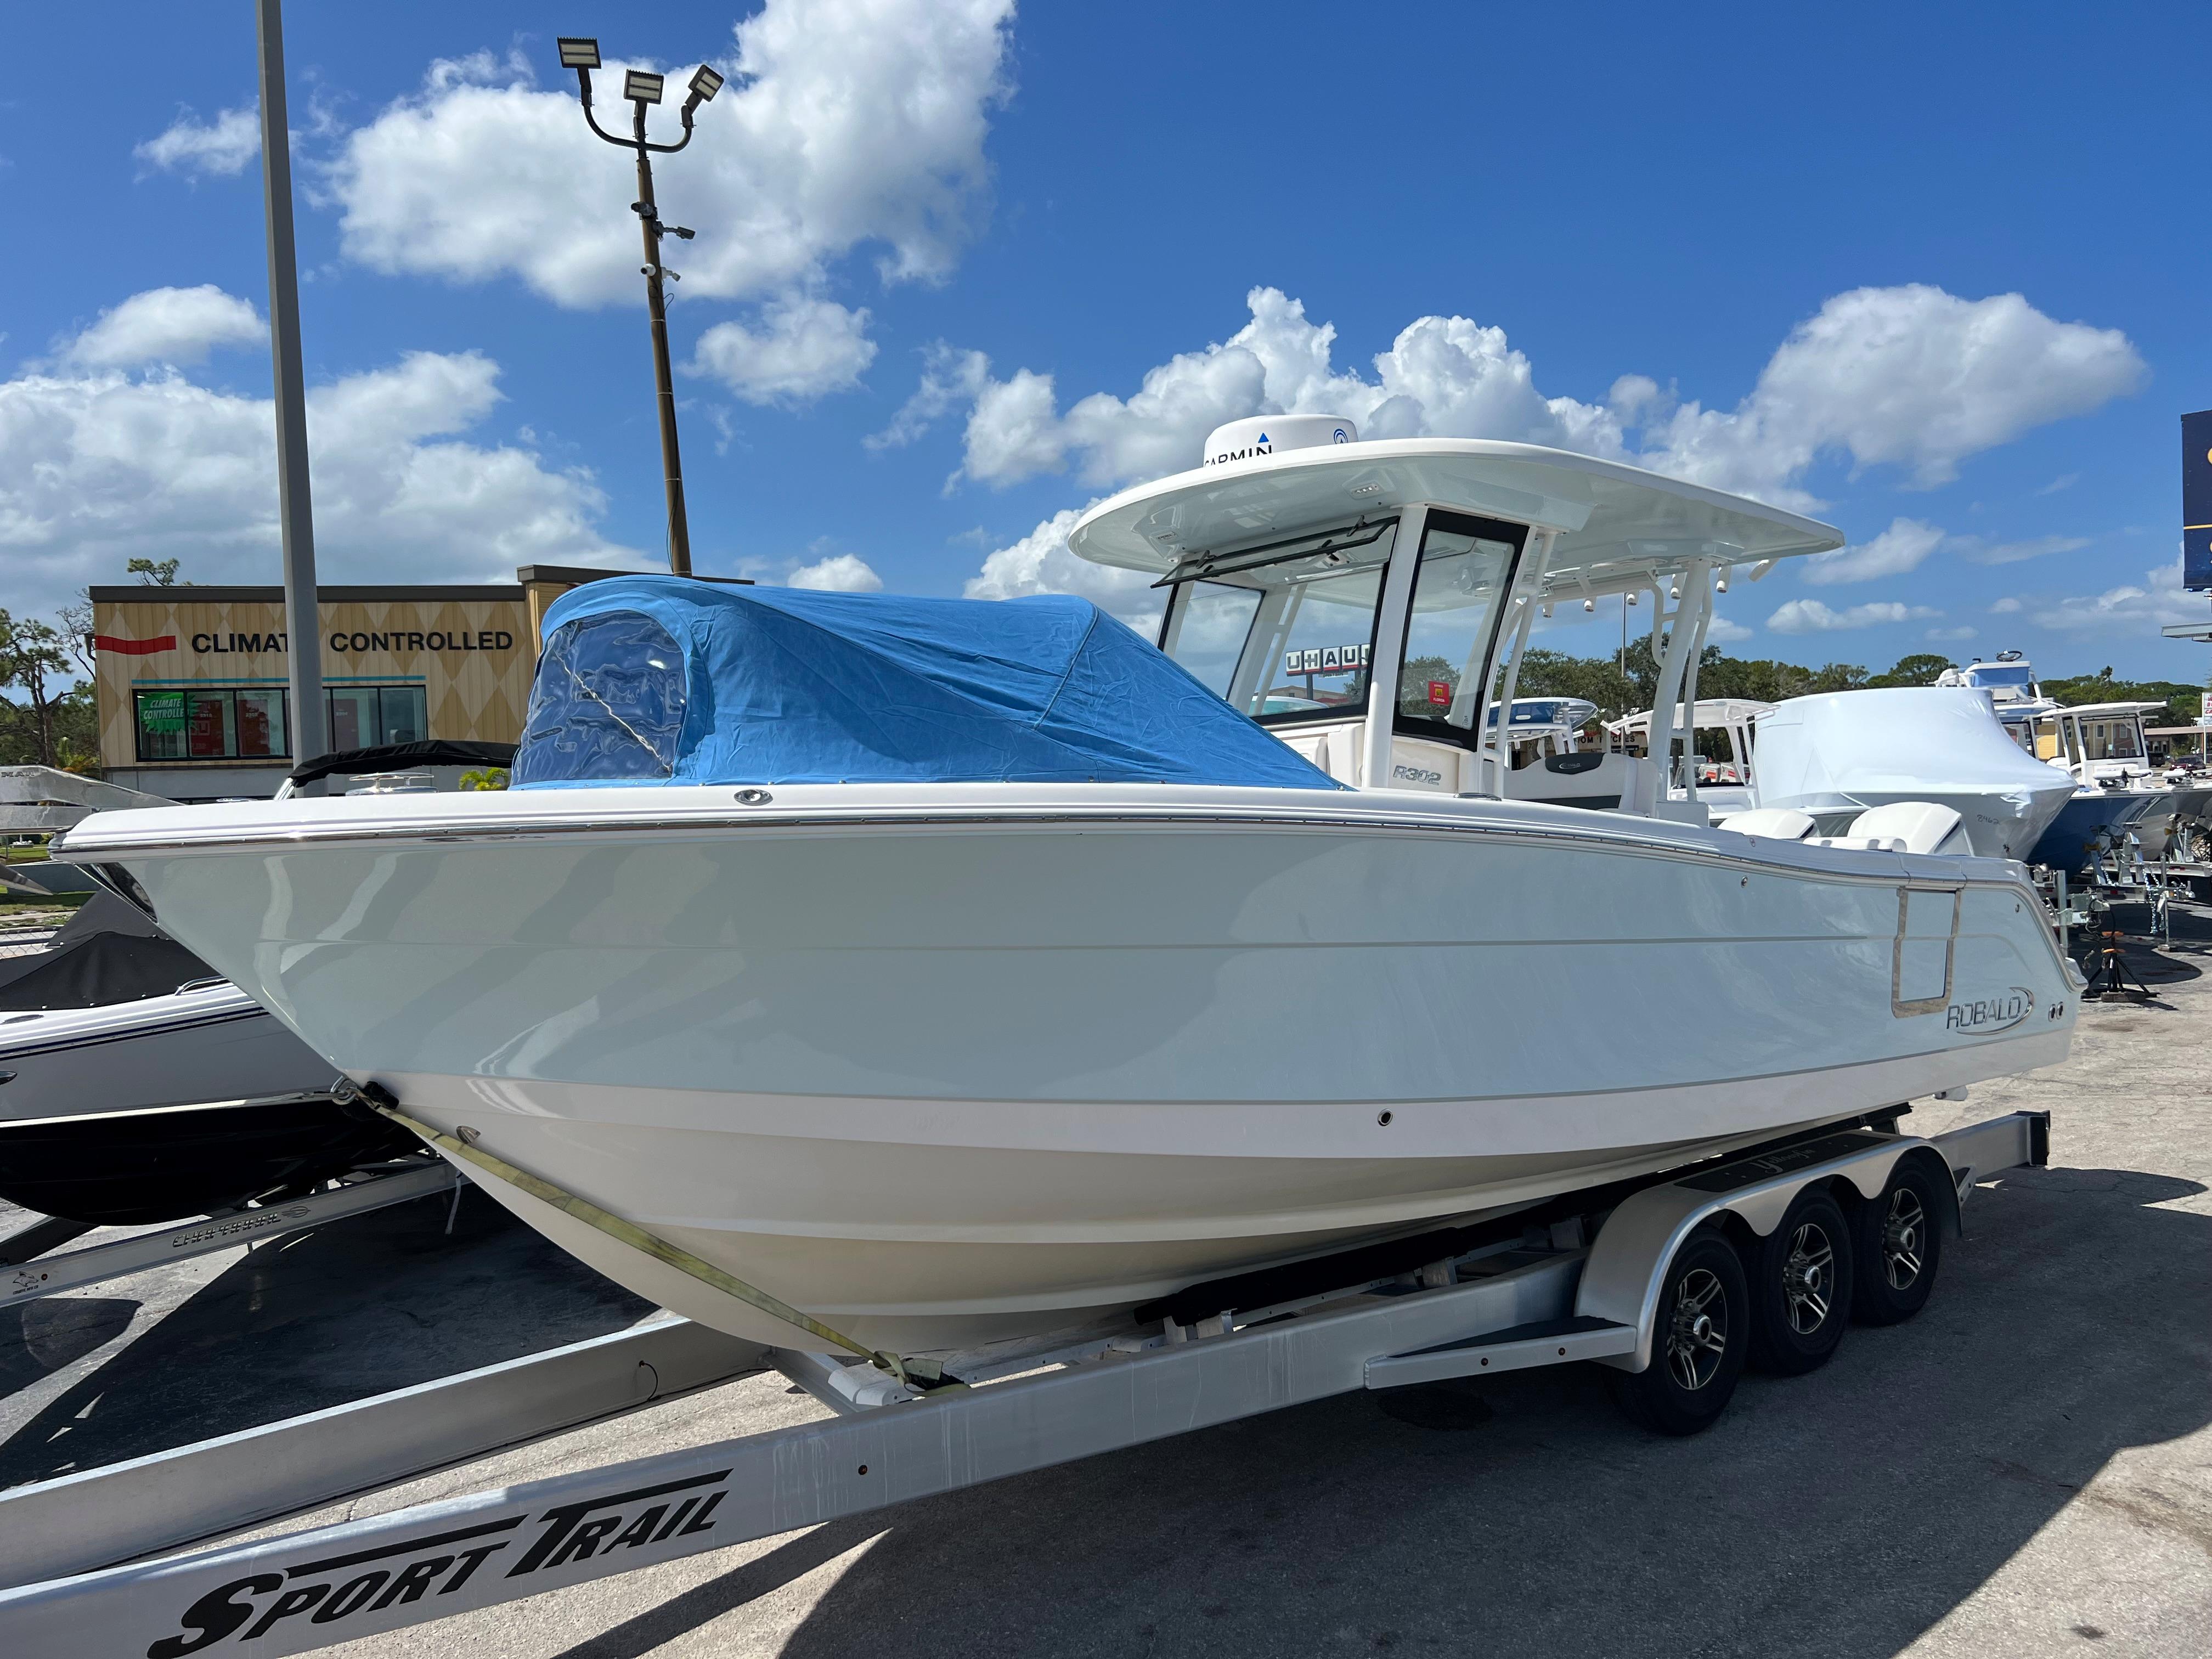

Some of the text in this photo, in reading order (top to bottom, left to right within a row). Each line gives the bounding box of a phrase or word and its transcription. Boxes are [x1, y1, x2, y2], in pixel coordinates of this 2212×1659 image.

[192, 631, 513, 653] CLIMAT CONTROLLED
[150, 698, 182, 708] CLIMATE
[143, 708, 189, 720] CONTROLLE
[1393, 765, 1441, 786] R302
[1946, 996, 2021, 1029] ROBALO
[148, 1468, 734, 1658] SPORT TRAIL
